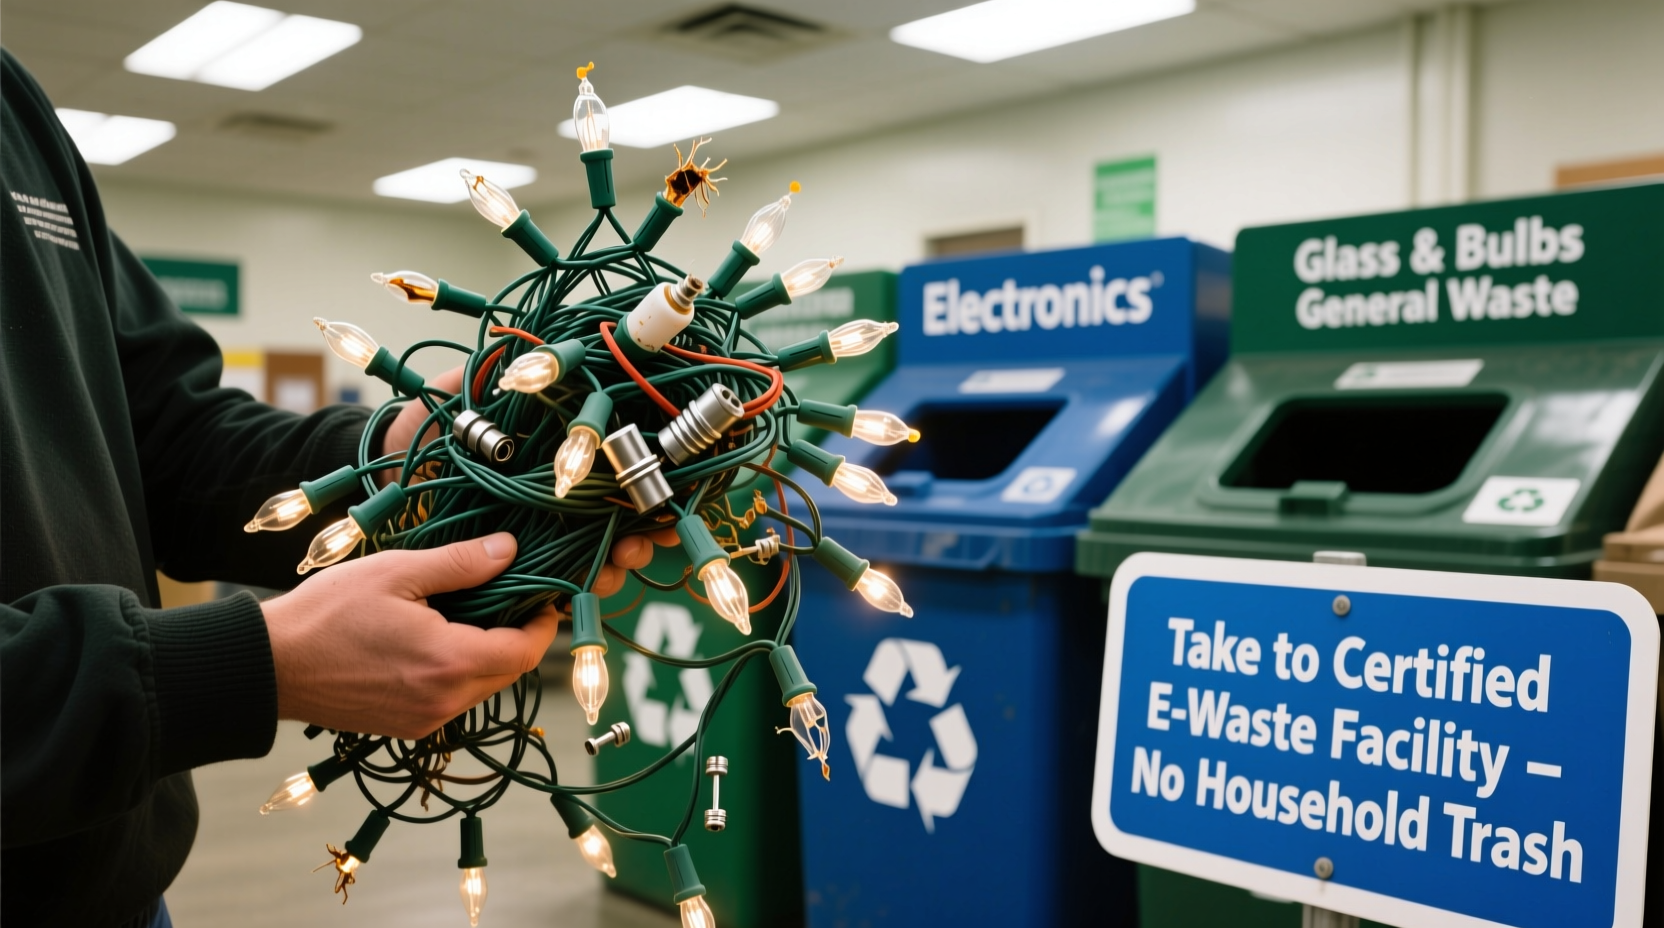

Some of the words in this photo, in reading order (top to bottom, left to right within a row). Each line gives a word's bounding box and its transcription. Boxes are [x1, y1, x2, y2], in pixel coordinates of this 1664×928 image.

[1294, 235, 1401, 284] Glass
[1409, 227, 1445, 275] &
[1455, 215, 1585, 271] Bulbs
[922, 265, 1155, 336] Electronics
[1295, 277, 1439, 329] General
[1446, 275, 1579, 321] Waste
[1168, 617, 1261, 676] Take
[1273, 632, 1320, 683] to
[1333, 636, 1552, 713] Certified
[1147, 681, 1317, 755] E-Waste
[1331, 708, 1510, 799] Facility
[1131, 746, 1185, 802] No
[1196, 757, 1430, 852] Household
[1443, 802, 1583, 884] Trash
